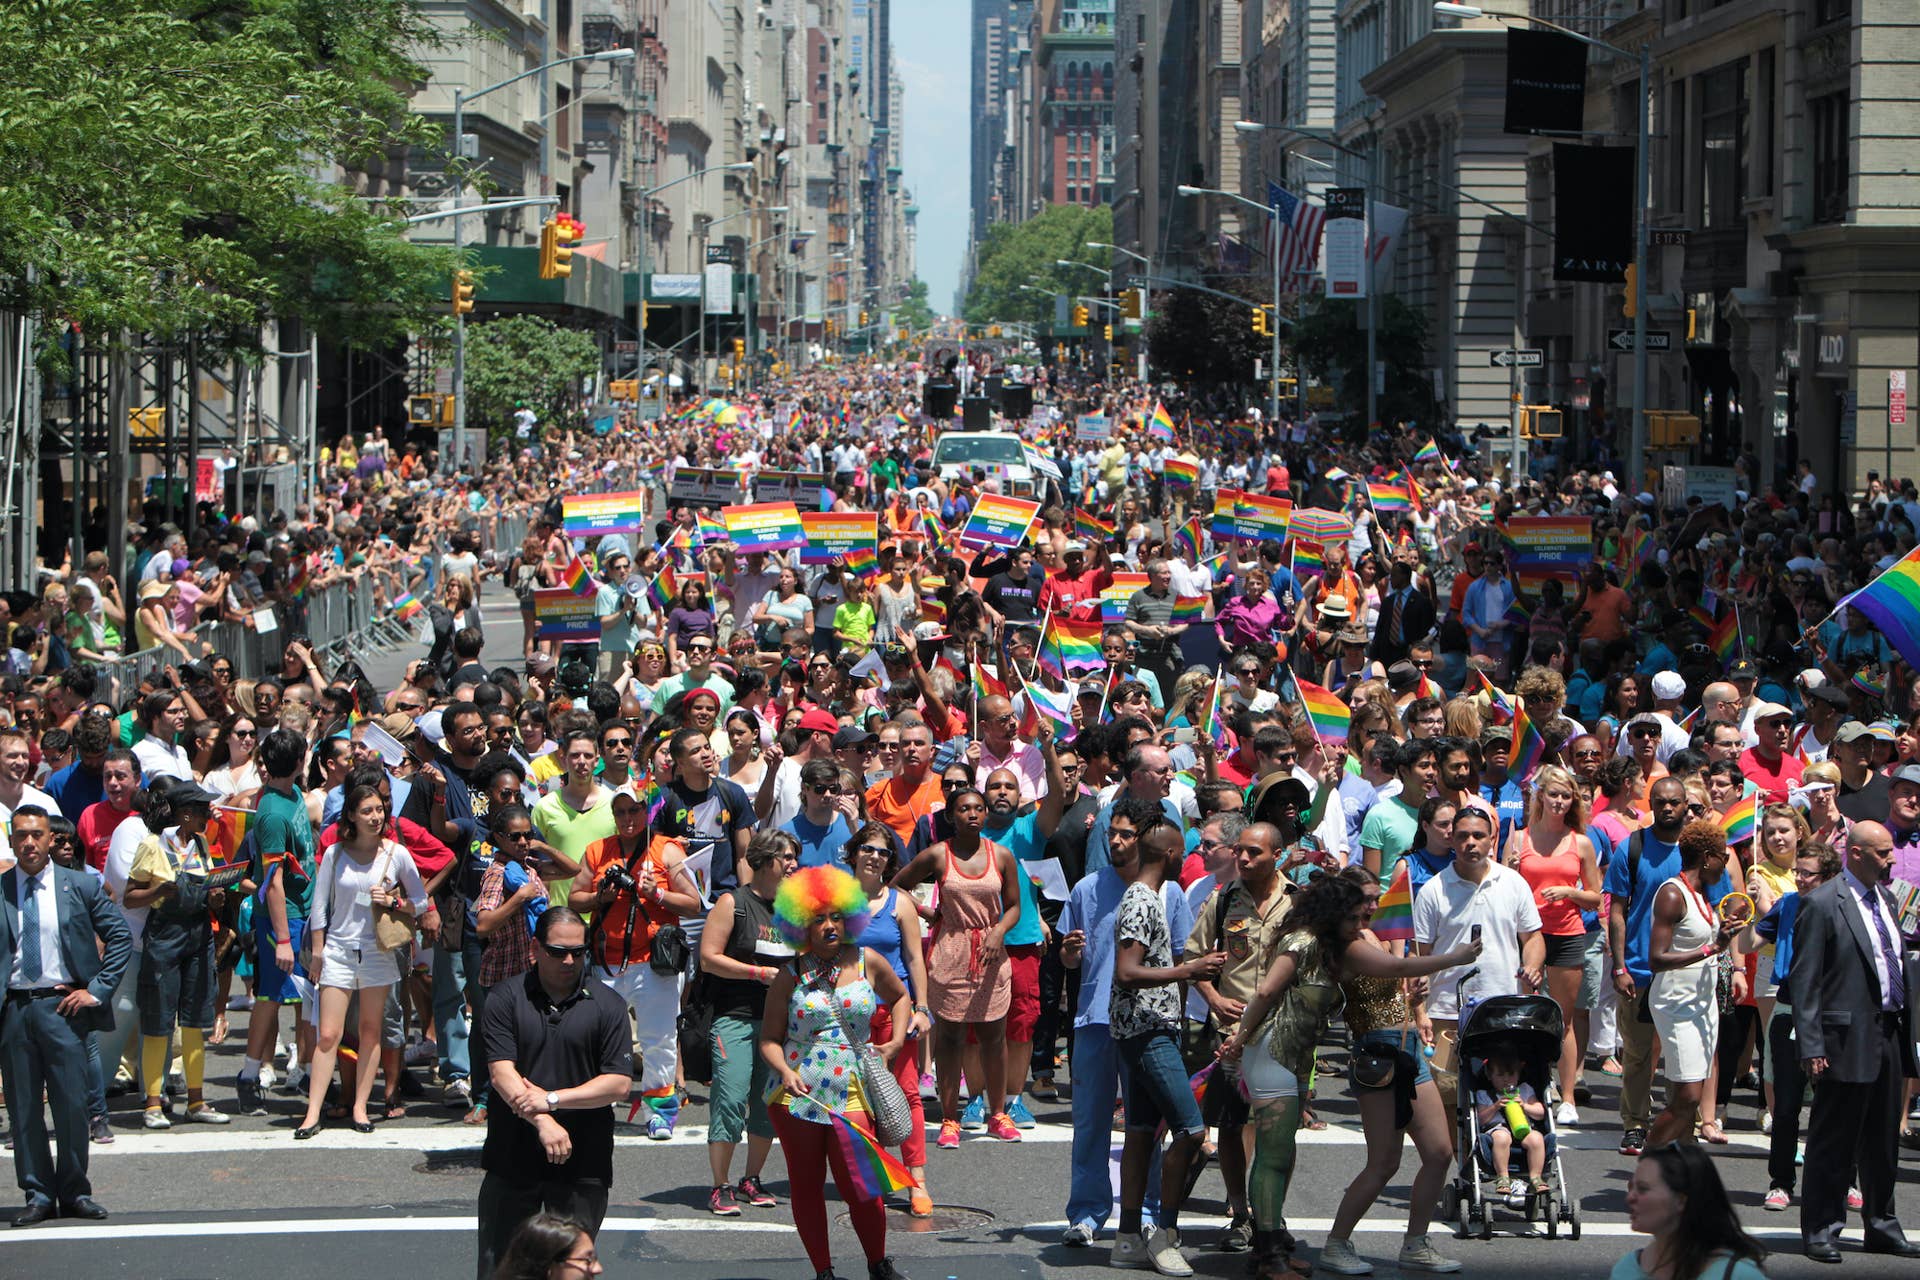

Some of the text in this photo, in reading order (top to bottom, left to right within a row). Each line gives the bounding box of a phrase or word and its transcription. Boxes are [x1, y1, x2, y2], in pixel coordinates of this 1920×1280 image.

[1655, 233, 1661, 244] E
[1663, 233, 1673, 244] 17
[1563, 258, 1625, 272] ZARA
[1619, 335, 1635, 344] ON
[1819, 335, 1844, 362] ALDO
[591, 519, 614, 527] PRIDE
[986, 525, 1004, 534] PRIDE
[1238, 526, 1260, 537] PRIDE
[757, 532, 780, 541] PRIDE
[827, 546, 849, 554] PRIDE
[1539, 552, 1561, 560] PRIDE
[567, 621, 589, 629] PRIDE
[1500, 800, 1523, 809] MORE
